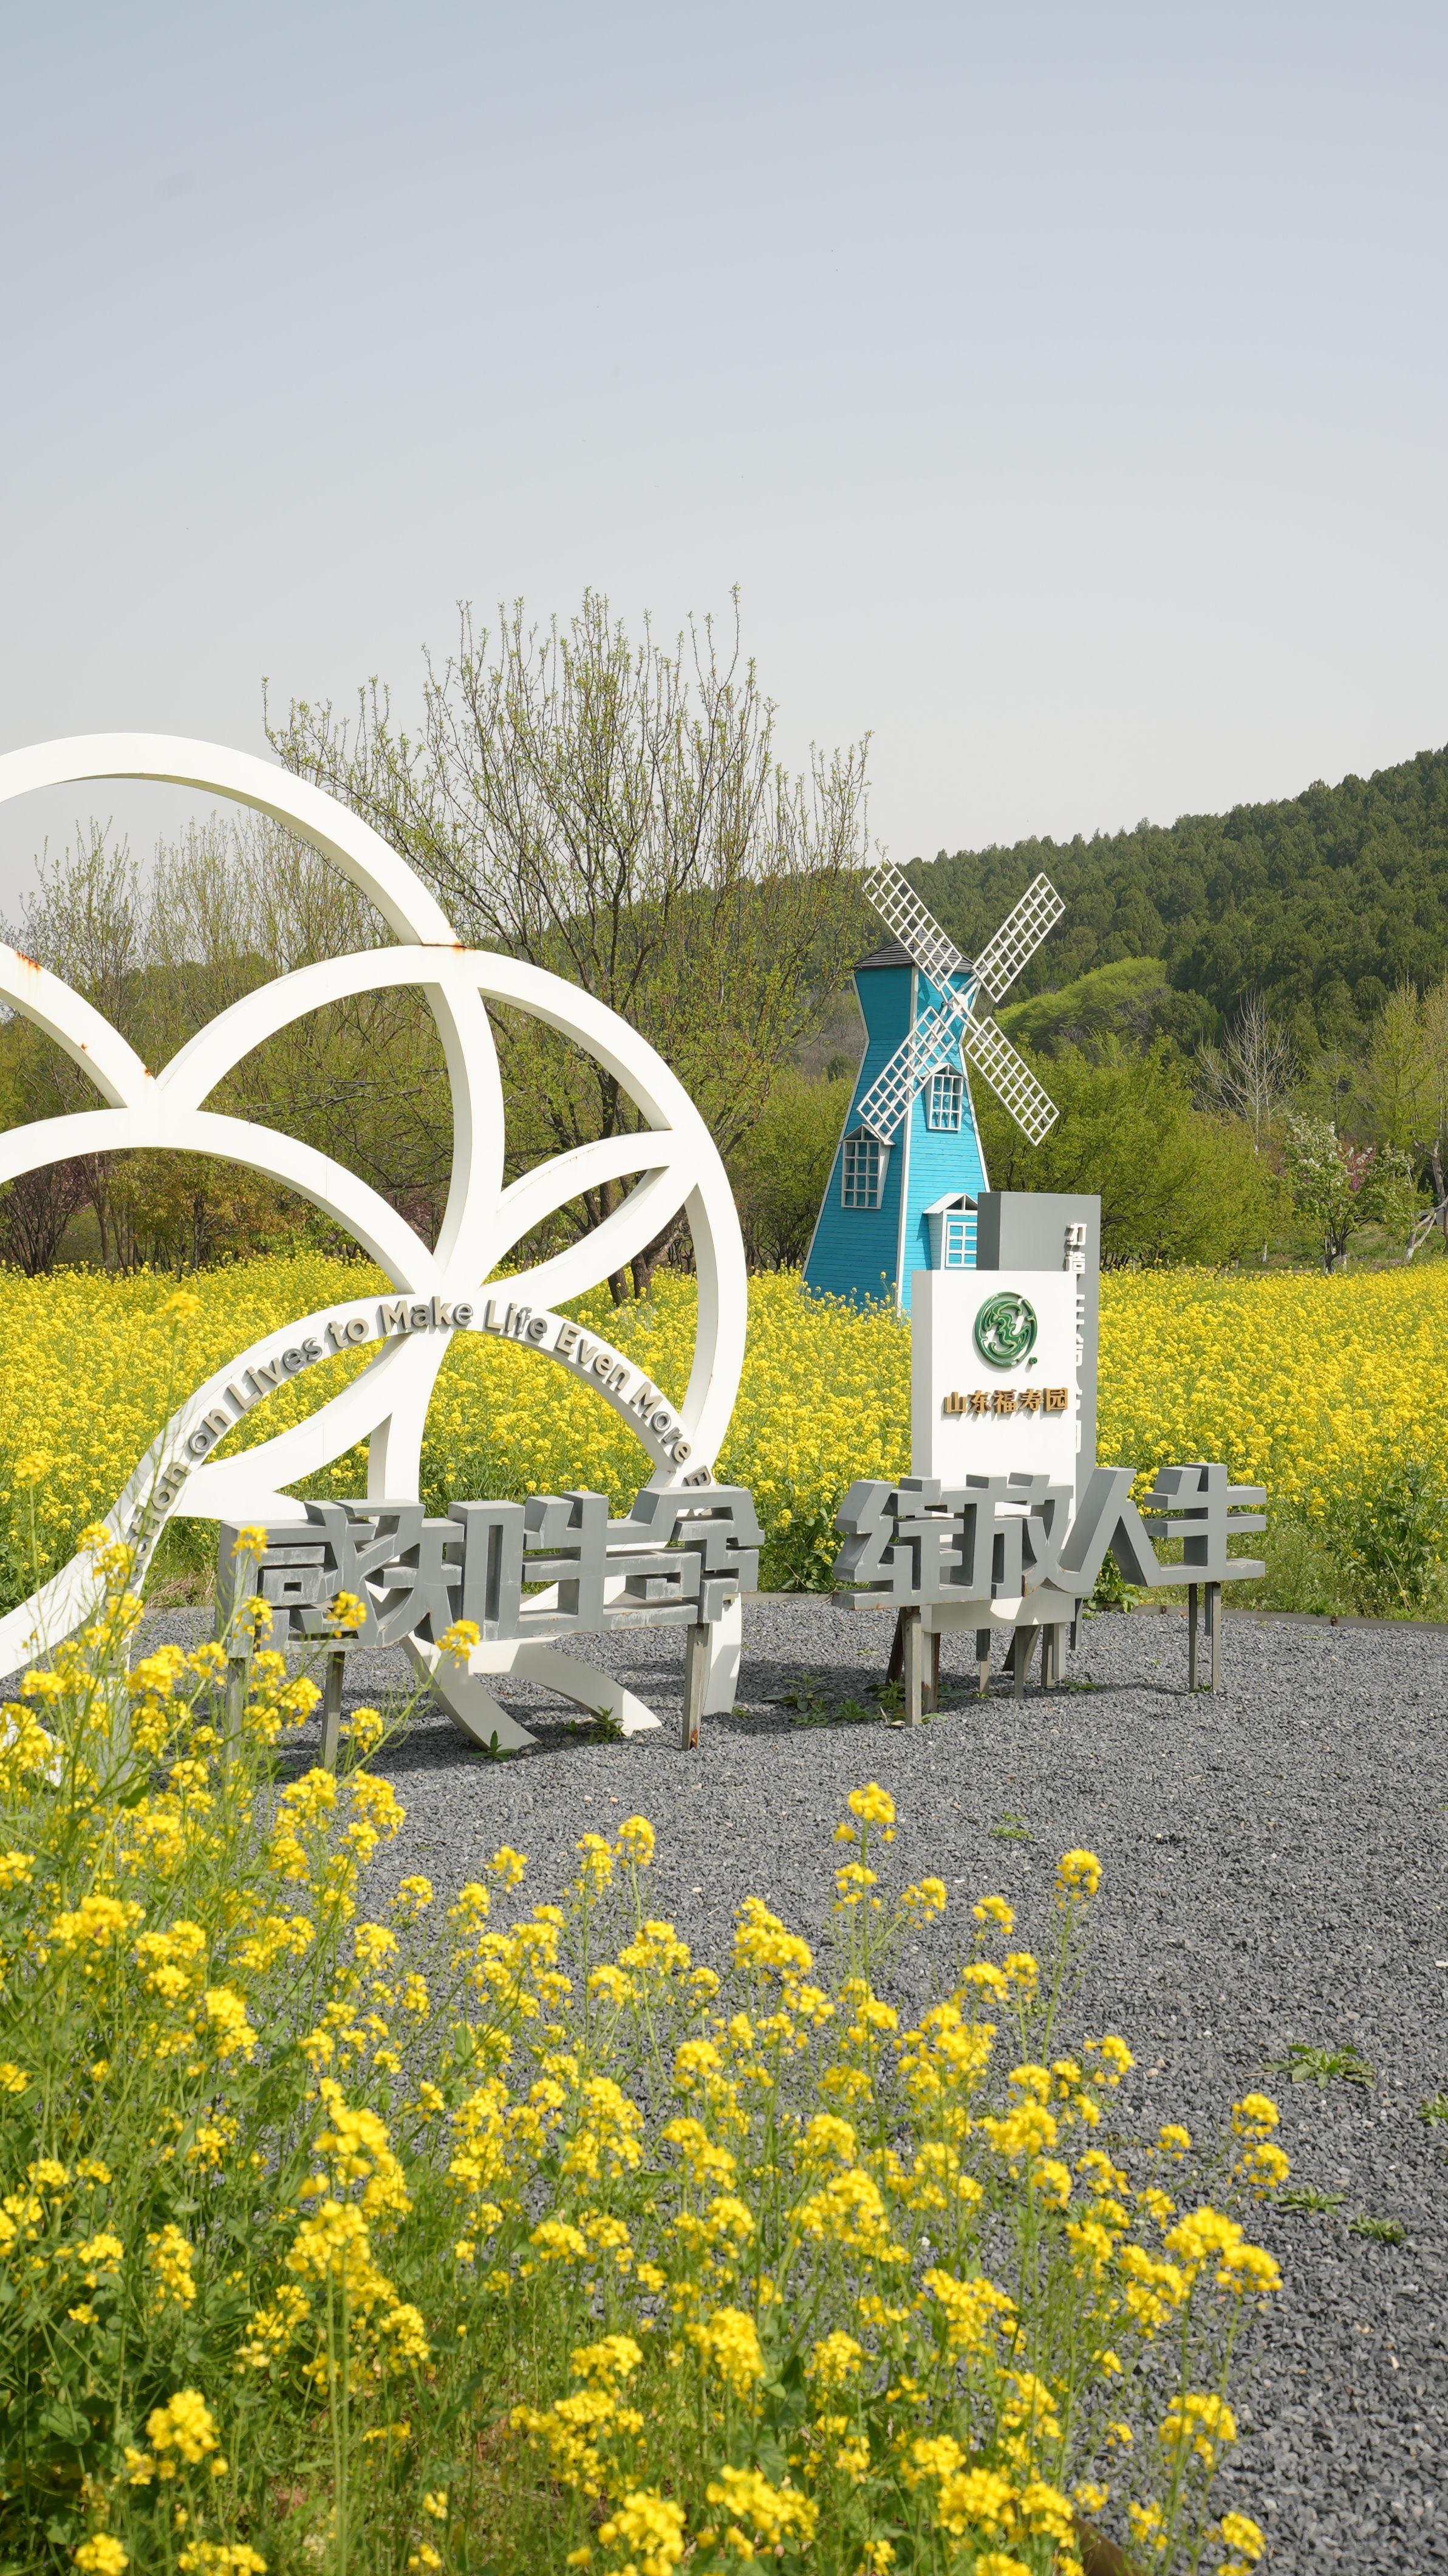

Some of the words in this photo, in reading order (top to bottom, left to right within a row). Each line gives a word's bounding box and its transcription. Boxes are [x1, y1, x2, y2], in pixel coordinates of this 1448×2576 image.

[1065, 1222, 1087, 1274] 打造
[188, 1408, 232, 1454] on
[227, 1337, 323, 1410] Lives
[328, 1318, 369, 1348] to
[378, 1296, 474, 1334] Make
[487, 1300, 548, 1340] Life
[556, 1322, 630, 1391] Even
[629, 1381, 692, 1464] More
[943, 1387, 1068, 1414] 山东福寿园
[211, 1485, 766, 1659] 感知生命
[832, 1462, 1267, 1611] 绽放人生
